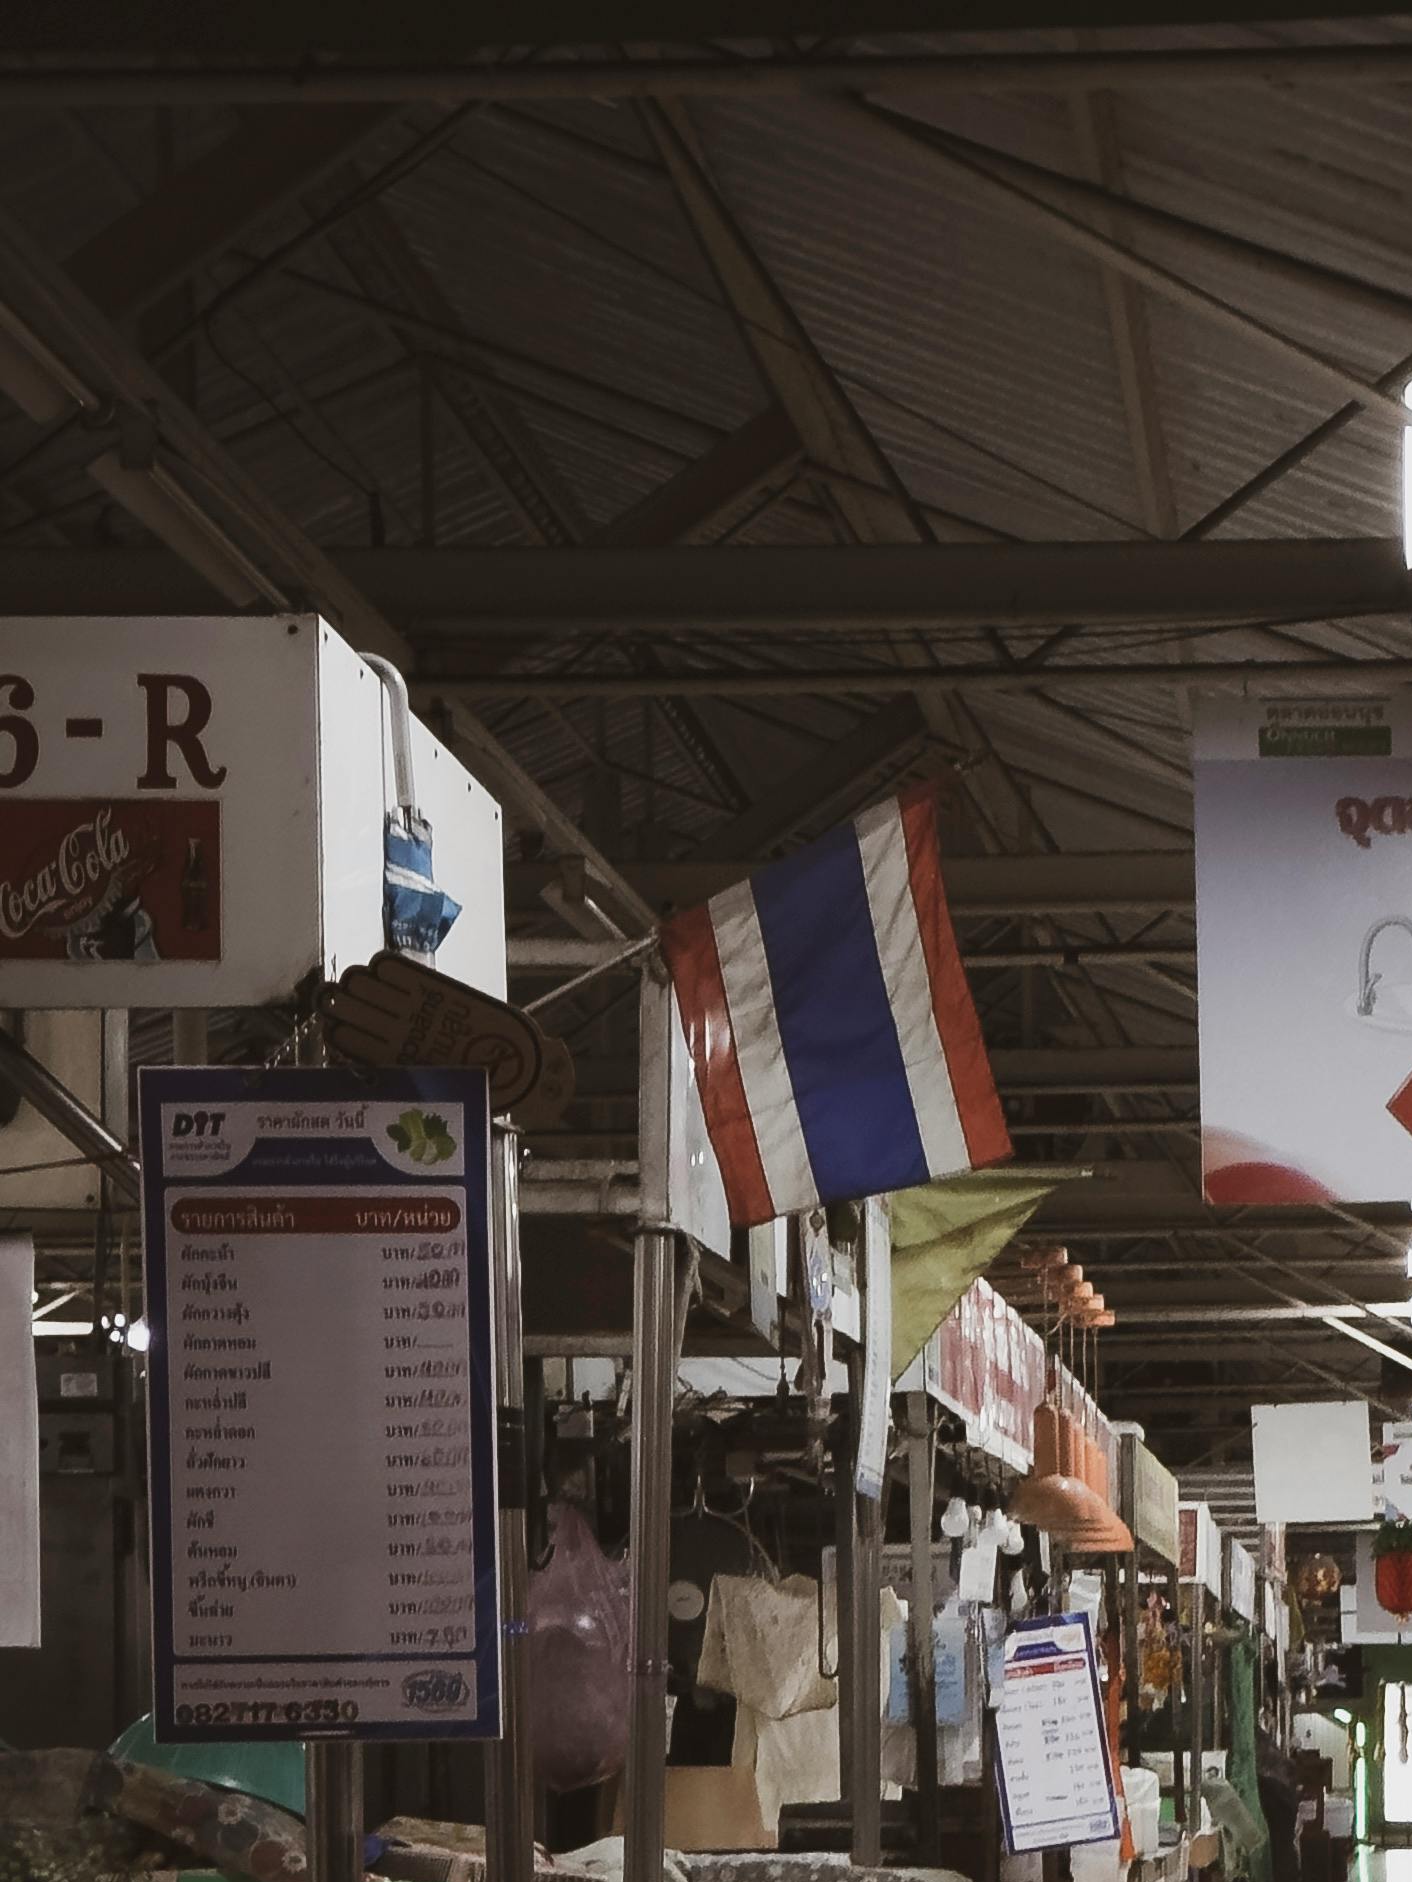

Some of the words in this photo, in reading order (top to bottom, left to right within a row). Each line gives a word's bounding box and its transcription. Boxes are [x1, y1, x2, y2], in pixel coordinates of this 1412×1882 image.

[0, 805, 130, 939] Coca-Cola
[180, 1202, 295, 1230] รายการสินค้า
[355, 1200, 452, 1228] บาท/หน่วย
